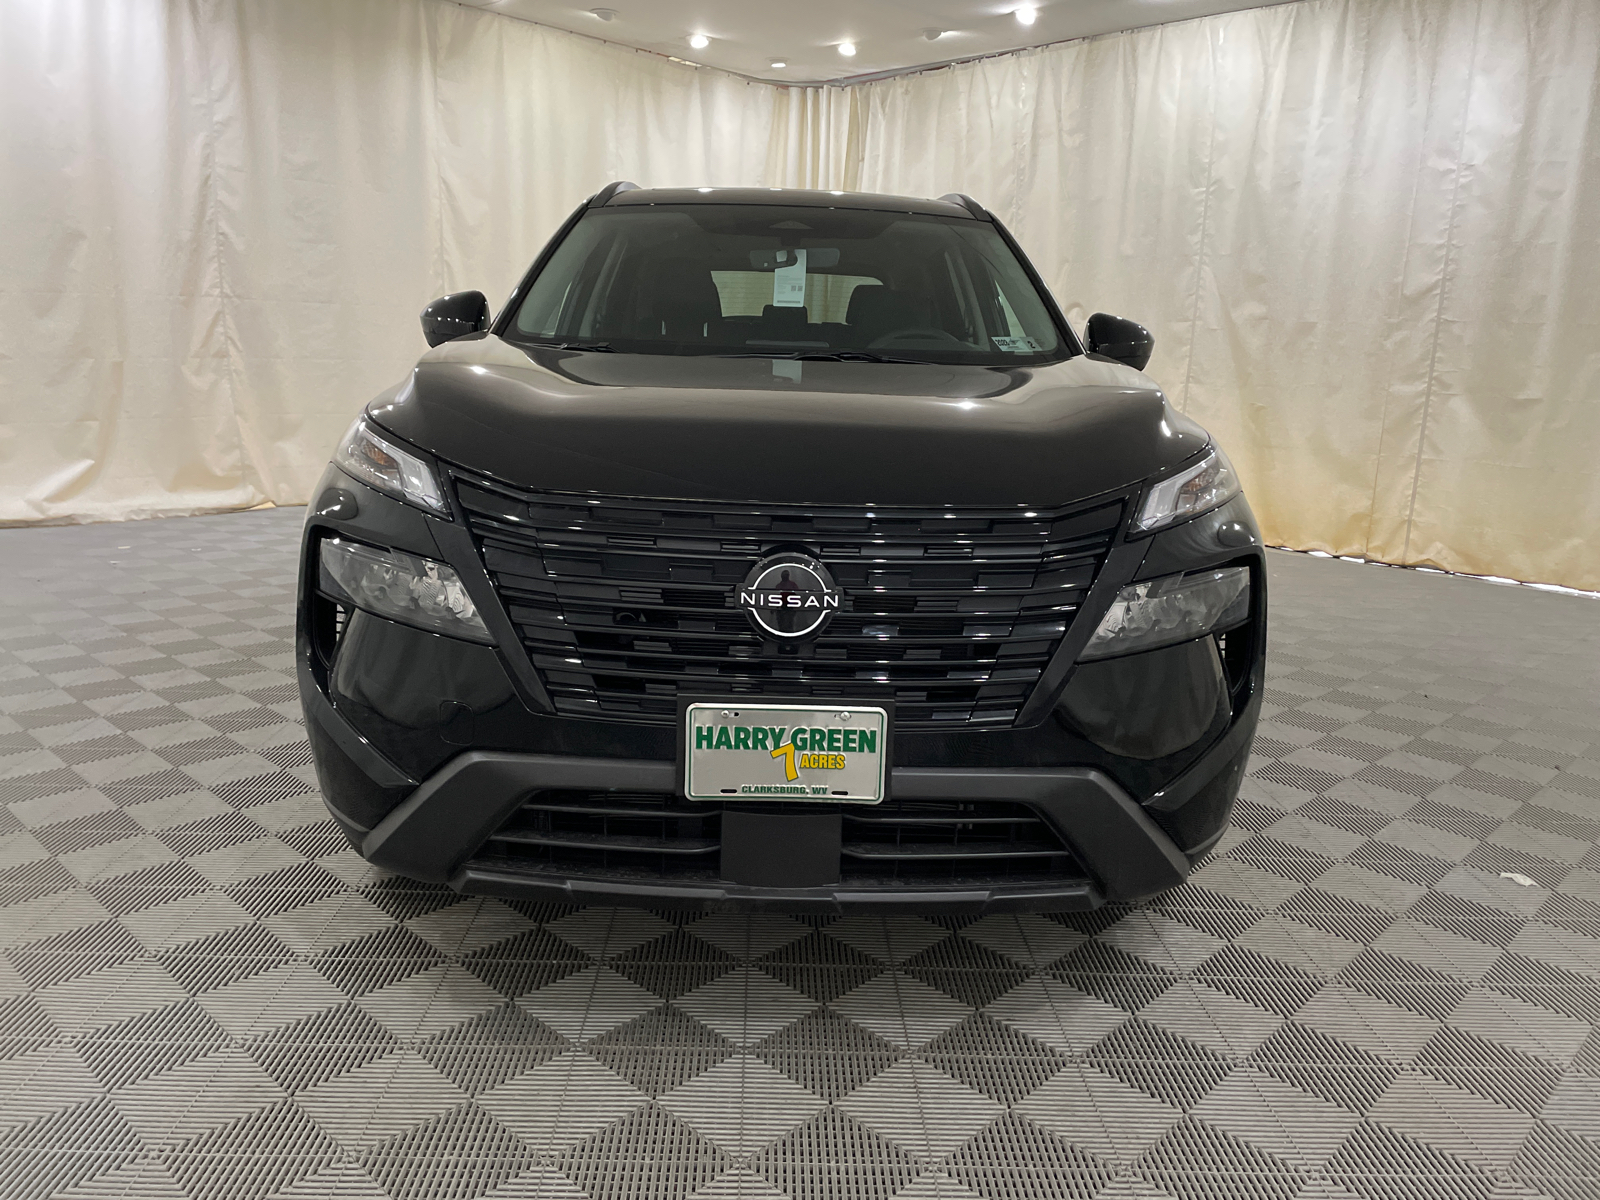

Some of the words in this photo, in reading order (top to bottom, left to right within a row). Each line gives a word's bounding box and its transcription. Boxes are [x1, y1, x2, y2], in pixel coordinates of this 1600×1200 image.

[740, 592, 839, 608] NISSAN
[695, 725, 787, 750] HARRY
[790, 727, 877, 753] GREEN
[770, 742, 798, 782] 7
[800, 753, 846, 770] ACRES
[741, 785, 809, 796] CLARKSBURG,
[812, 786, 828, 795] WV
